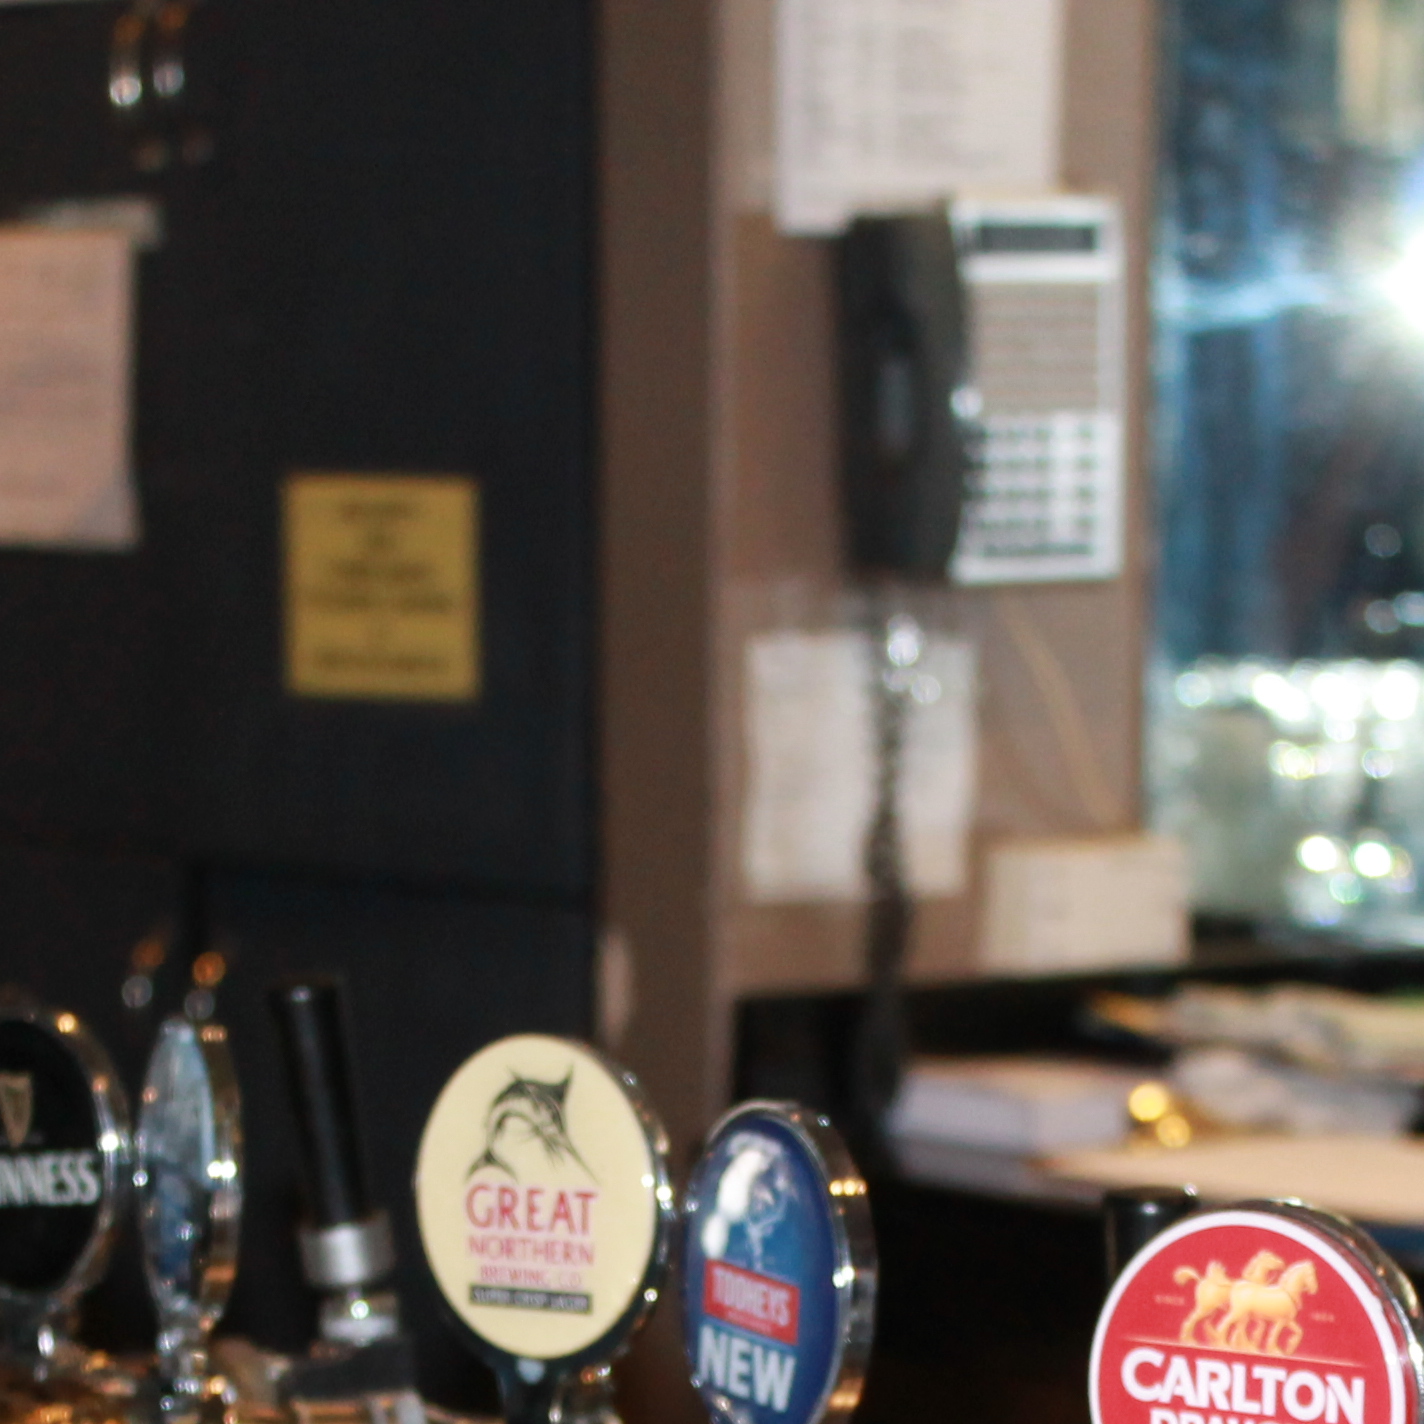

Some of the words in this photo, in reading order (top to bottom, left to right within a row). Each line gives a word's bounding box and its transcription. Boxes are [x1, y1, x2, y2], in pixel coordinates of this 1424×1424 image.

[465, 1184, 598, 1235] GREAT
[467, 1234, 595, 1266] NORTHERN
[711, 1266, 792, 1328] TOOHEYS
[698, 1323, 797, 1413] NEW
